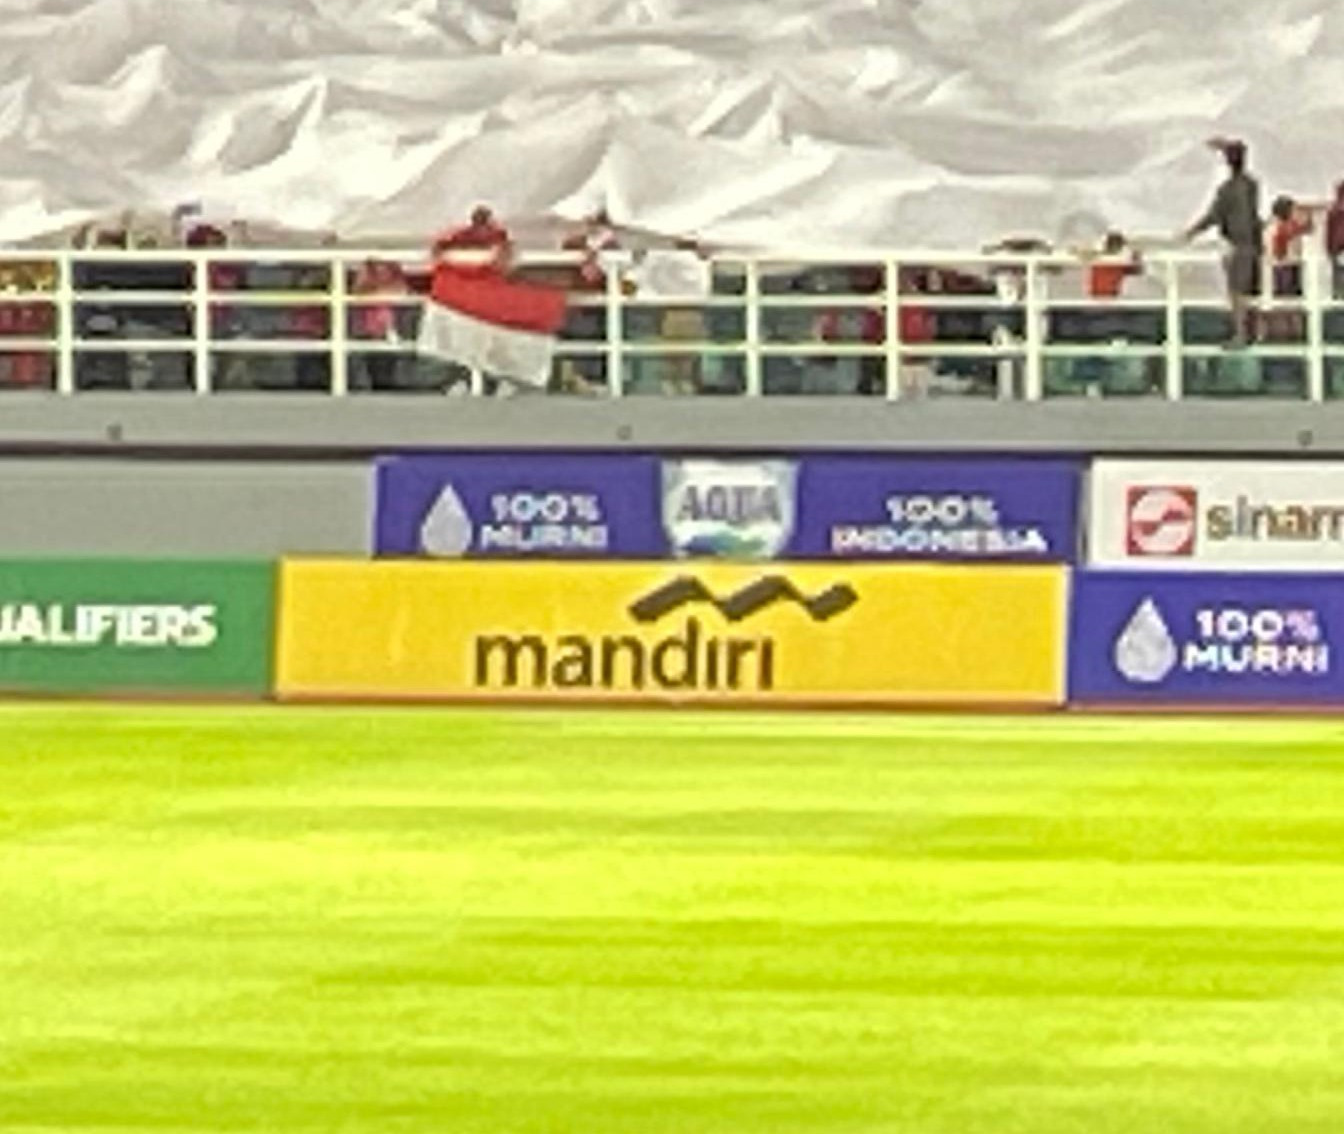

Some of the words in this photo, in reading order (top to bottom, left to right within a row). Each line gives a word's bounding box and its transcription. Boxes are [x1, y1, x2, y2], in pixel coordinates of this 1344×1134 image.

[491, 494, 600, 523] 100%
[676, 485, 783, 526] AQUA
[886, 494, 1000, 525] 100%
[480, 524, 606, 550] MURNI
[831, 526, 1048, 553] INDONESIA
[1197, 610, 1319, 641] 100%
[475, 616, 773, 690] mandiri
[1183, 643, 1329, 672] MURNI
